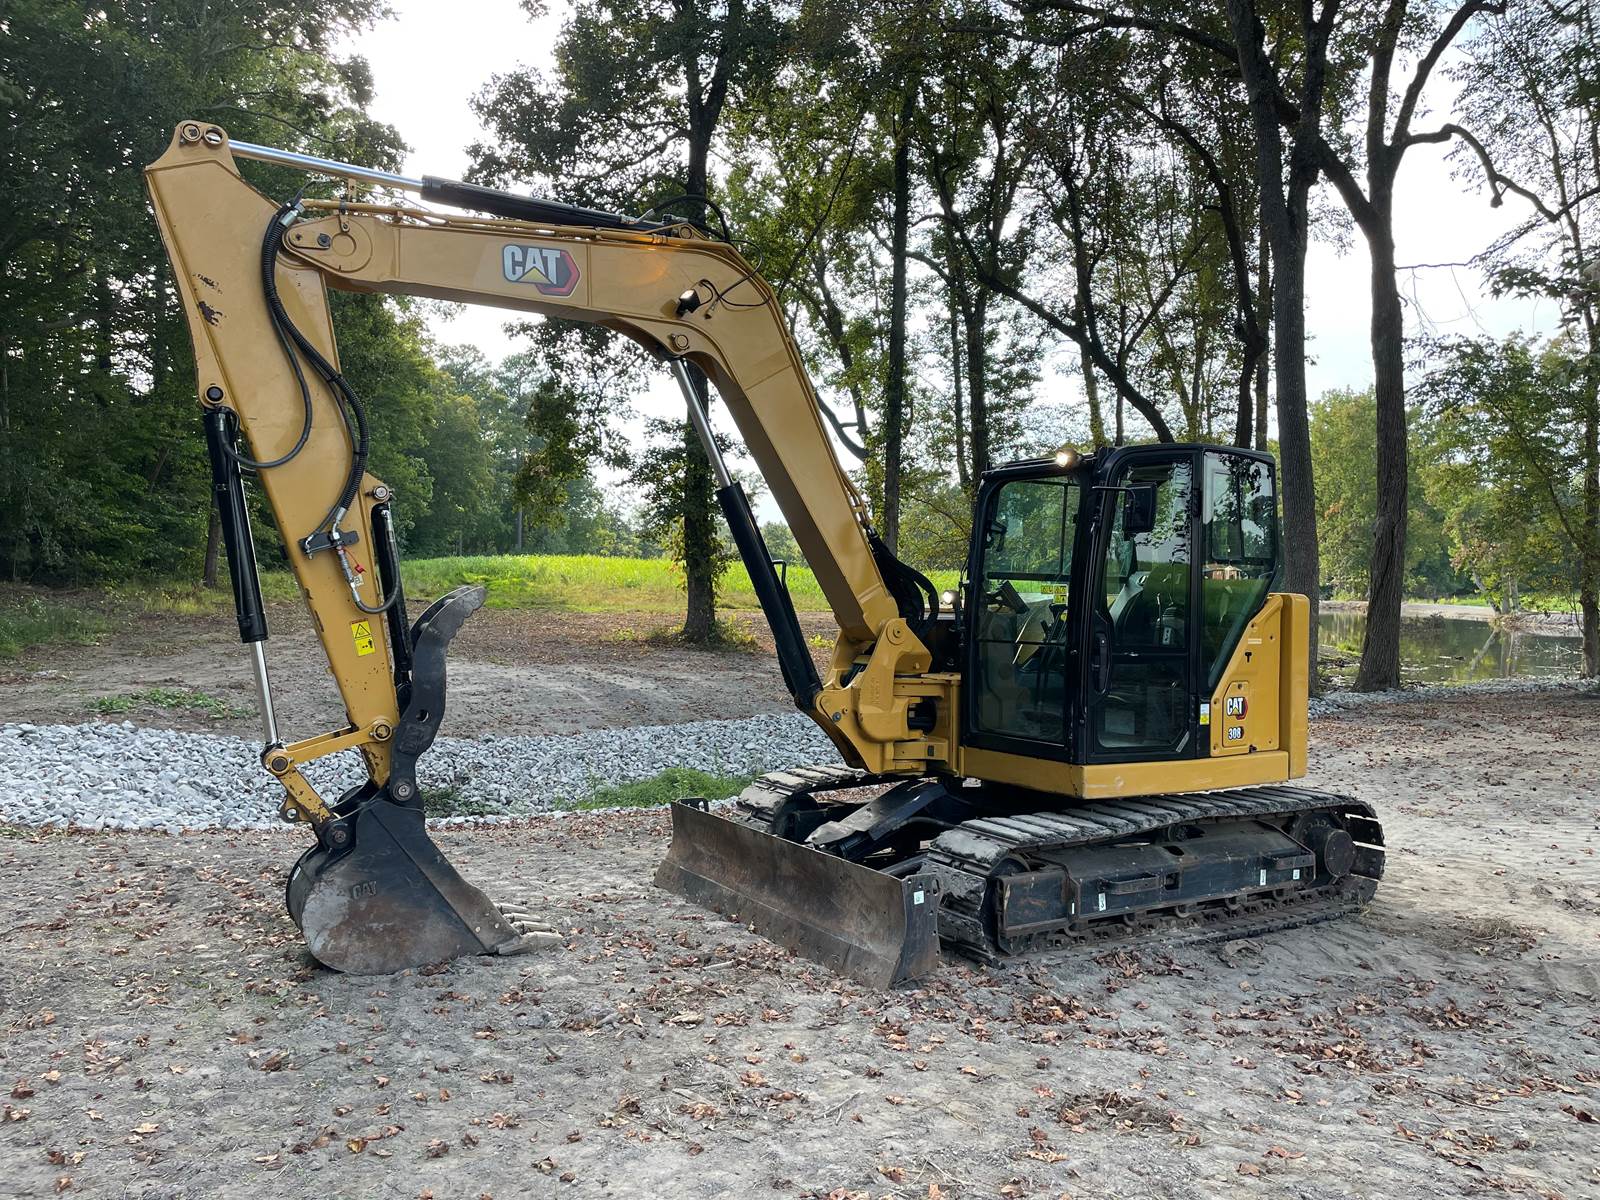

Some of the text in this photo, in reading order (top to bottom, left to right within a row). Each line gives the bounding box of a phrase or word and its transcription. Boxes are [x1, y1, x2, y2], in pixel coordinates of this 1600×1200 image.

[503, 245, 561, 285] CAT
[1227, 697, 1244, 716] CAT
[1228, 727, 1241, 740] 308
[352, 880, 377, 900] CAT
